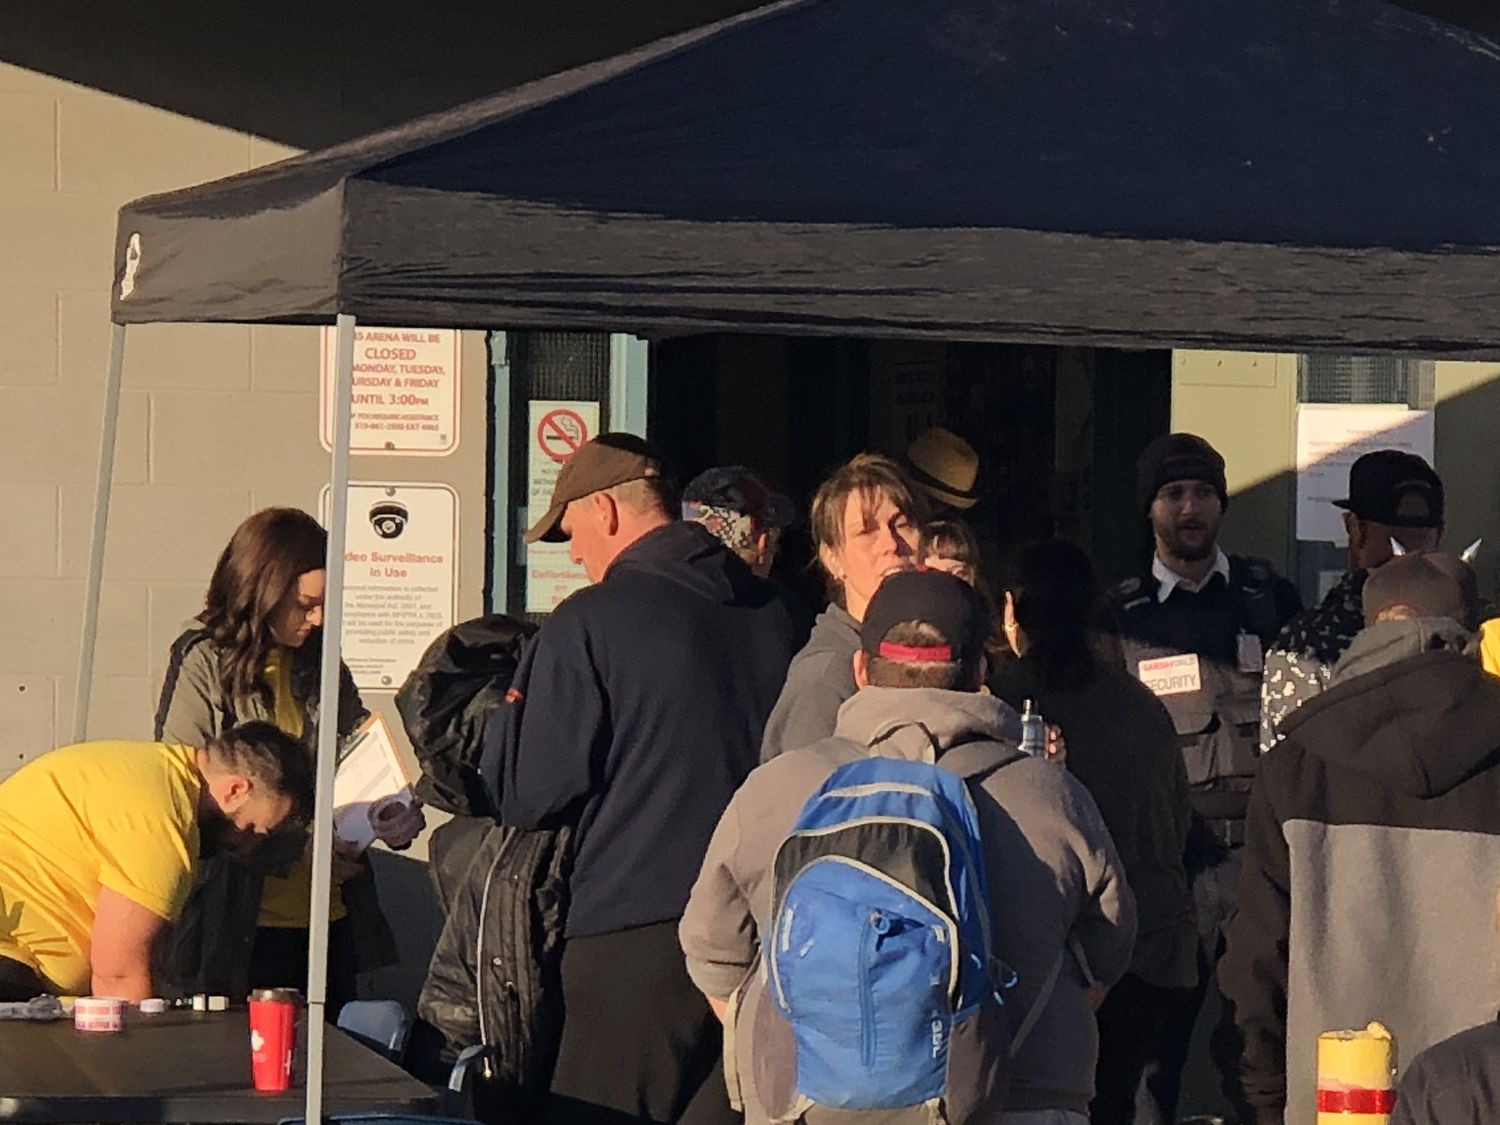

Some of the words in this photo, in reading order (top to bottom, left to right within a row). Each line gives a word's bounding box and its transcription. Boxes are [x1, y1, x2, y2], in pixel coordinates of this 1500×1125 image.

[366, 332, 400, 341] ARENA
[402, 333, 426, 343] WILL
[428, 334, 440, 343] BE
[365, 347, 417, 360] CLOSED
[400, 364, 446, 375] TUESDAY,
[352, 376, 392, 387] URSDAY
[404, 378, 440, 388] FRIDAY
[344, 551, 368, 562] deo
[371, 551, 444, 564] Surveillance
[384, 567, 408, 578] Use
